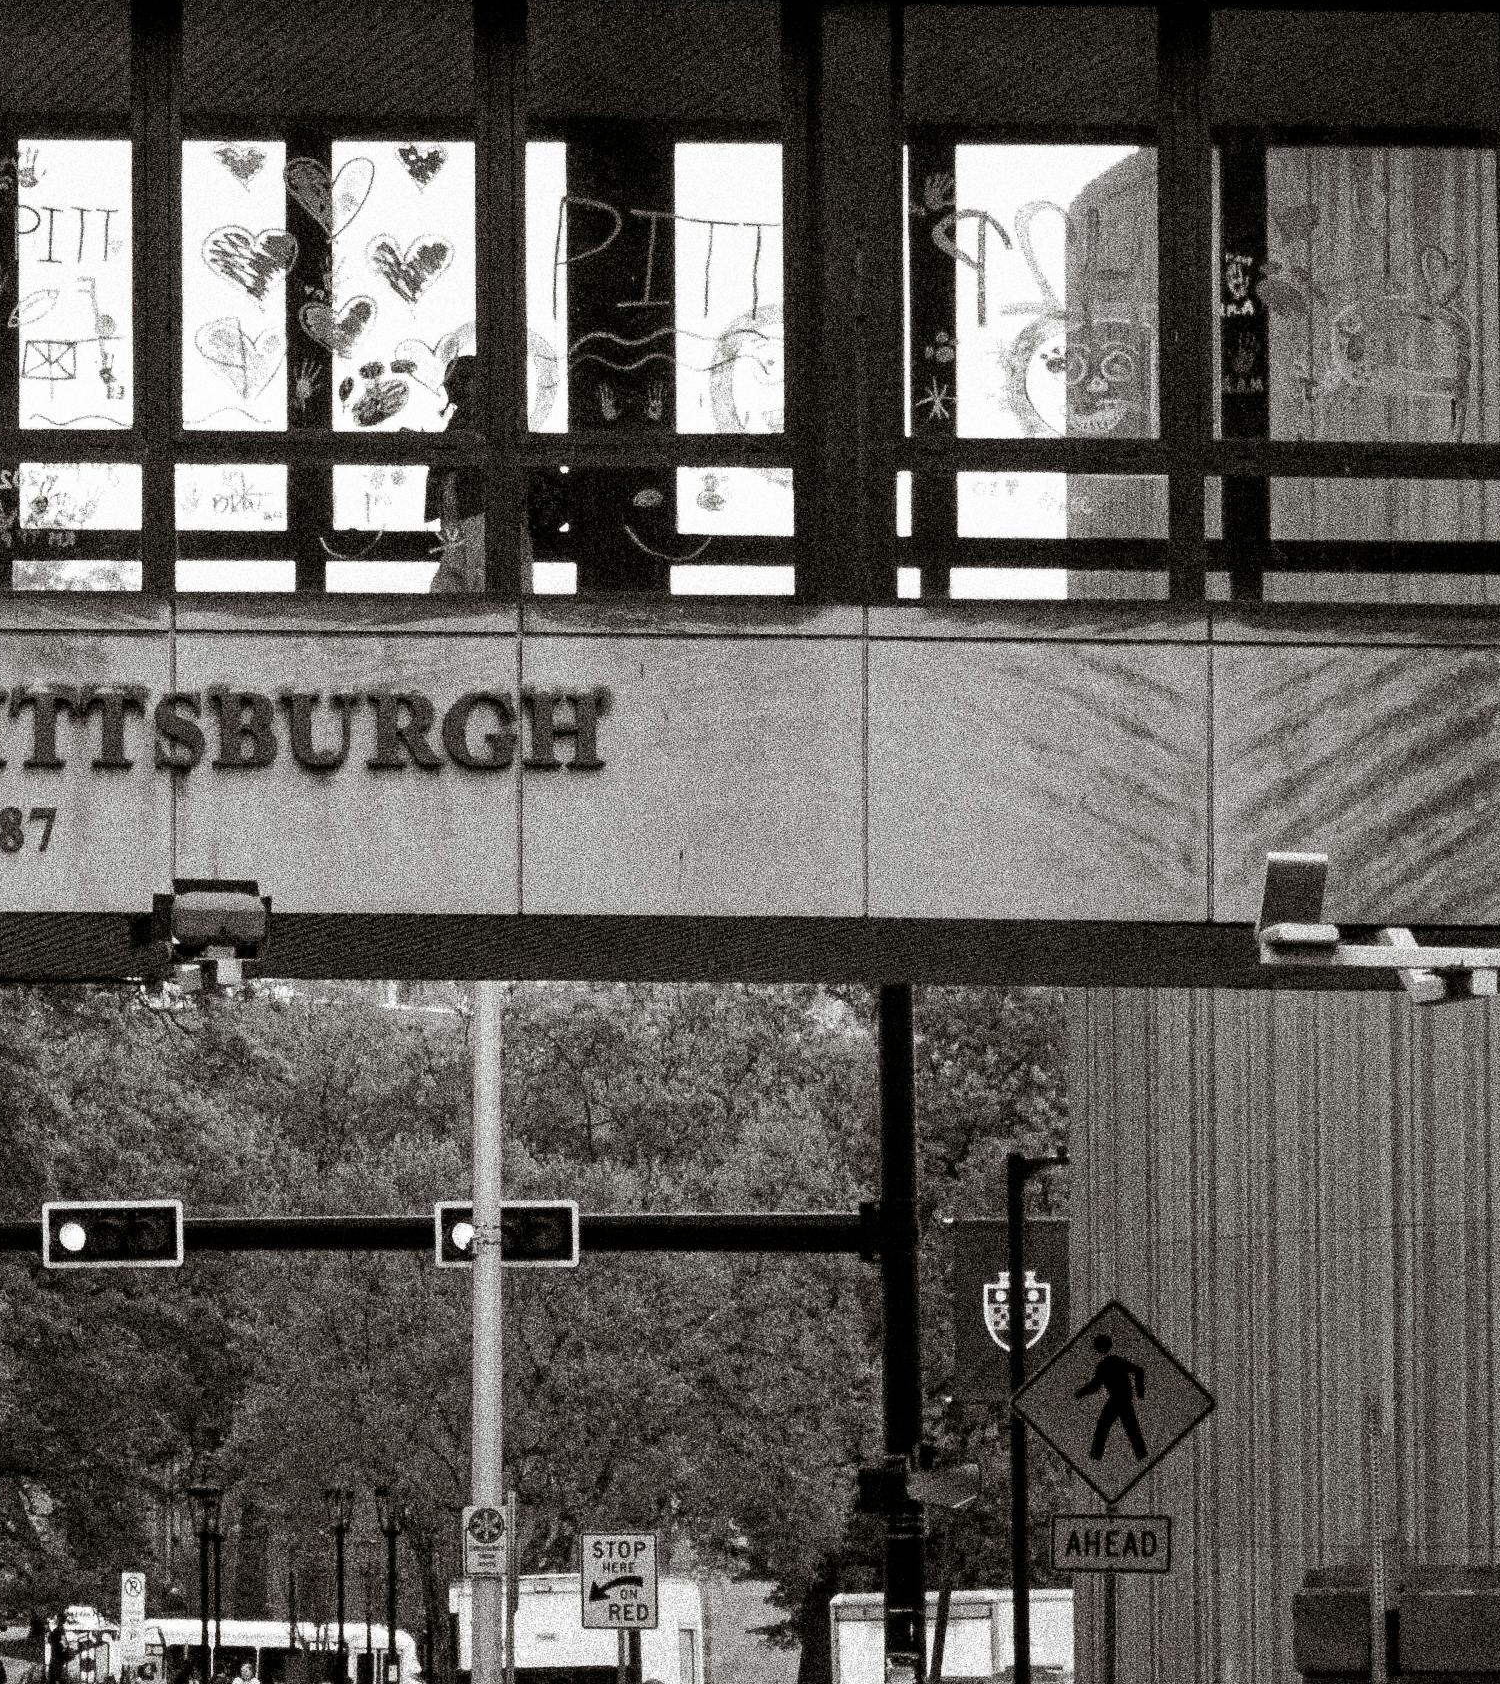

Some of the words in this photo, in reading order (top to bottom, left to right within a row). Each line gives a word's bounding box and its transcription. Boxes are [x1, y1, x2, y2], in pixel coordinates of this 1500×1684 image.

[553, 196, 781, 320] PITT
[592, 1540, 647, 1562] STOP
[1066, 1529, 1160, 1560] AHEAD
[602, 1562, 635, 1574] HERE
[619, 1586, 639, 1601] ON
[608, 1601, 649, 1622] RED
